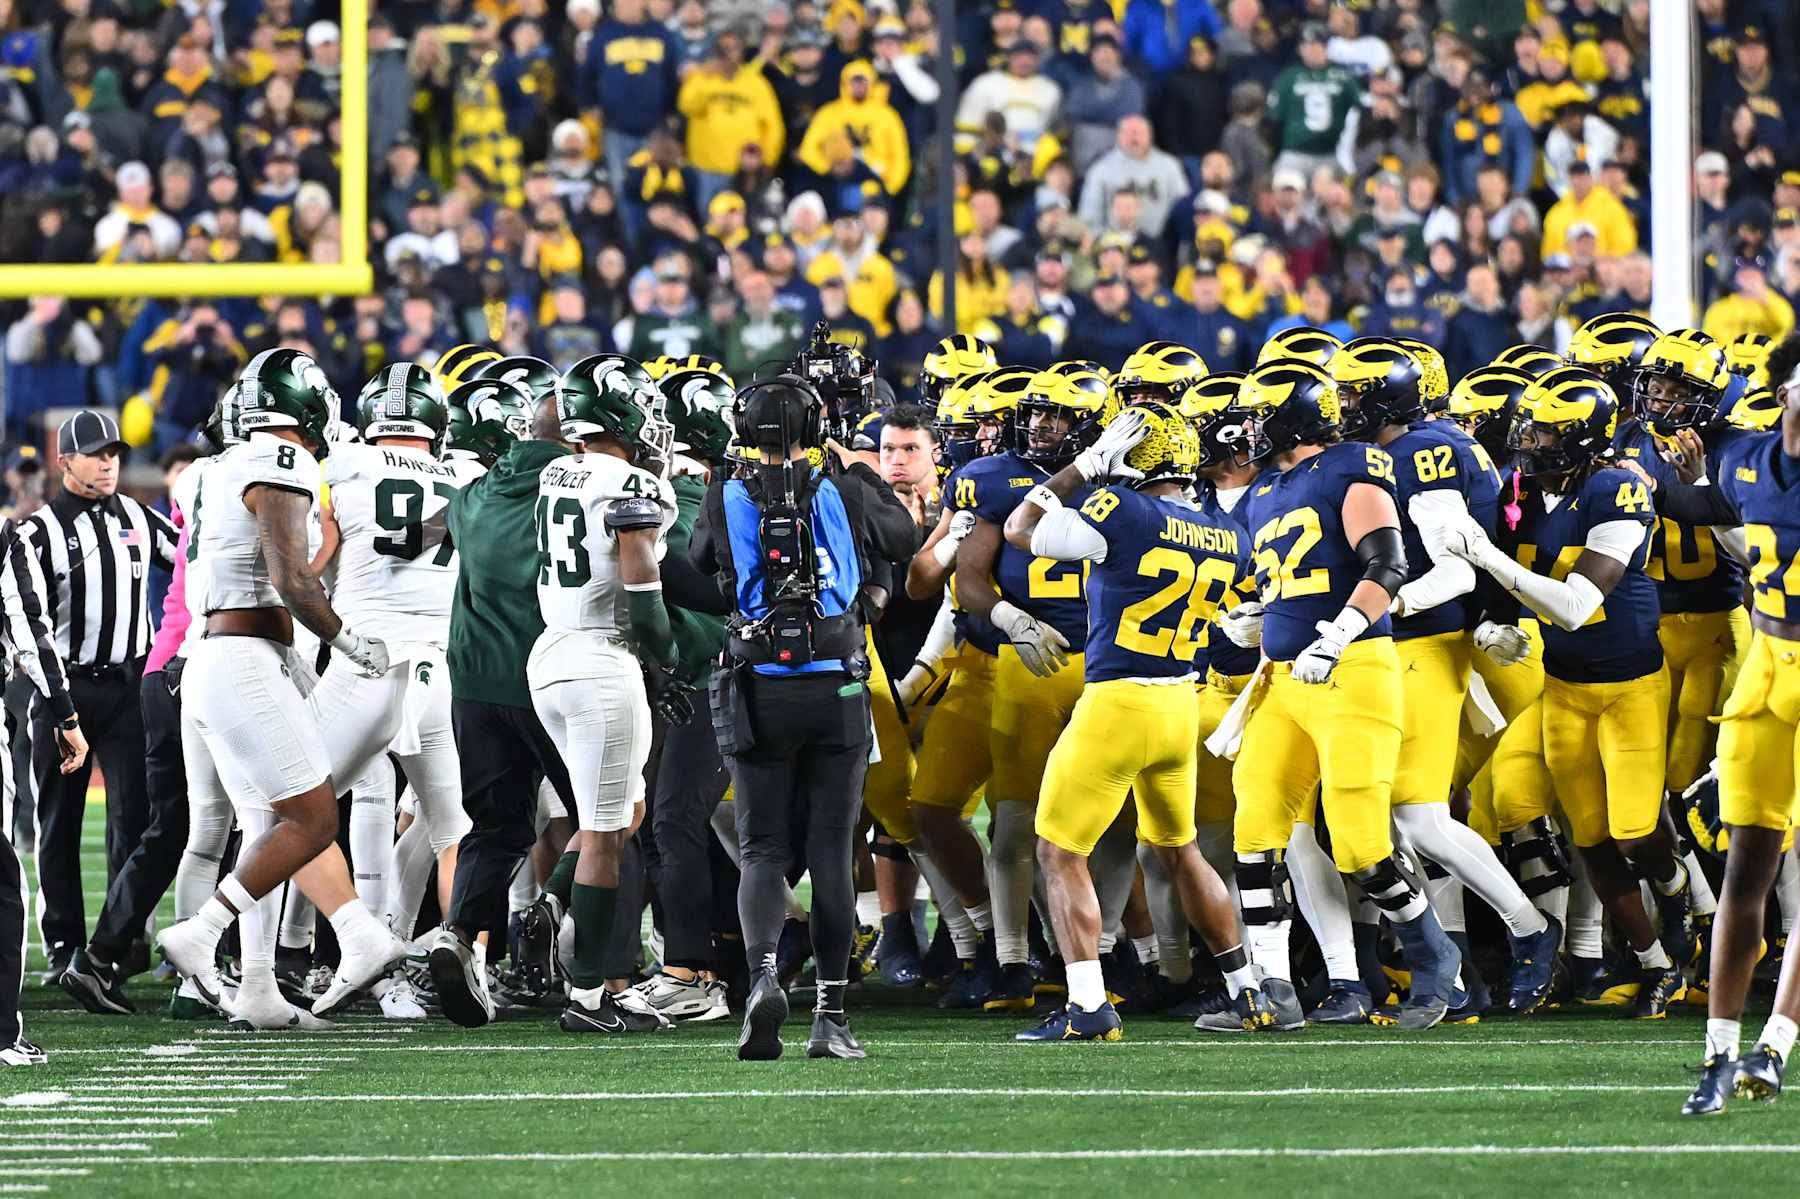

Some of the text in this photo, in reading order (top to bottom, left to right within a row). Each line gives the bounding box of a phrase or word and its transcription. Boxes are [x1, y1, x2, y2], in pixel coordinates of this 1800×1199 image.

[378, 424, 415, 433] SPARTANS
[276, 445, 296, 470] 8
[382, 450, 457, 478] HANSEN
[1365, 447, 1397, 486] 52
[1413, 445, 1457, 483] 82
[542, 466, 592, 489] SPENCER
[622, 473, 661, 500] 43
[1079, 487, 1120, 523] 28
[1615, 482, 1652, 513] 44
[67, 536, 80, 550] S
[1159, 515, 1239, 555] JOHNSON
[131, 561, 142, 579] U
[1253, 506, 1331, 609] 52
[1114, 546, 1236, 662] 28
